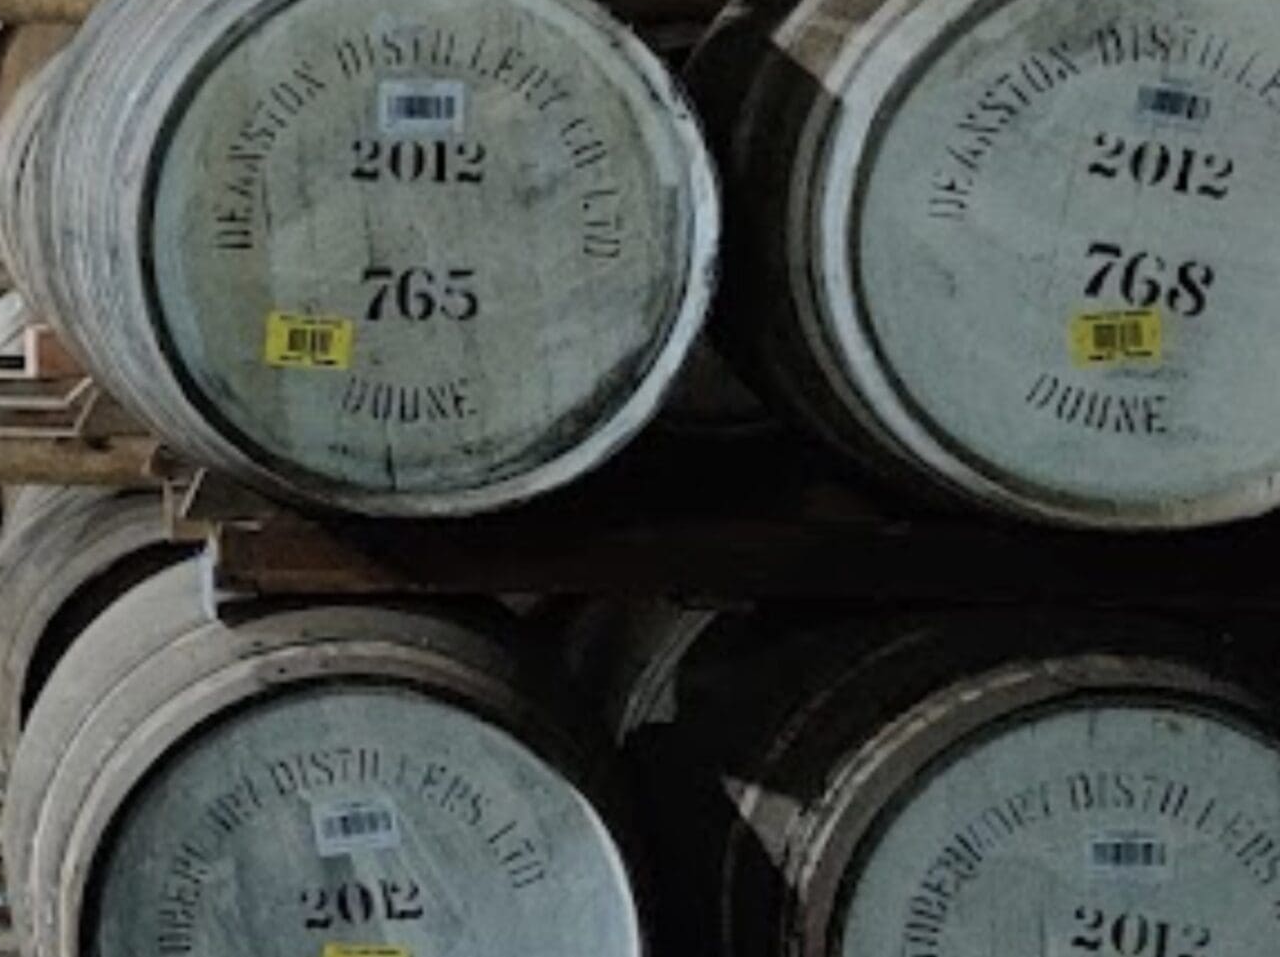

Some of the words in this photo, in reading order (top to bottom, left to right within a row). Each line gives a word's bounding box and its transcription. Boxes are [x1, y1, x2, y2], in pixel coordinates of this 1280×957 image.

[213, 58, 326, 251] DEANSTON
[334, 28, 570, 112] DISTILLERY
[580, 187, 625, 260] LTD
[926, 39, 1083, 221] DEANSTON
[1094, 18, 1280, 116] DISTILLE
[350, 138, 488, 185] 2012
[1087, 131, 1235, 202] 2012
[361, 264, 481, 324] 765
[1083, 241, 1216, 319] 768
[341, 374, 479, 425] DOUNE
[1023, 372, 1169, 437] DOUNE
[268, 746, 494, 828] DISTILLERS
[486, 820, 547, 890] LTD
[299, 878, 426, 931] 2012
[1069, 904, 1214, 957] 2012
